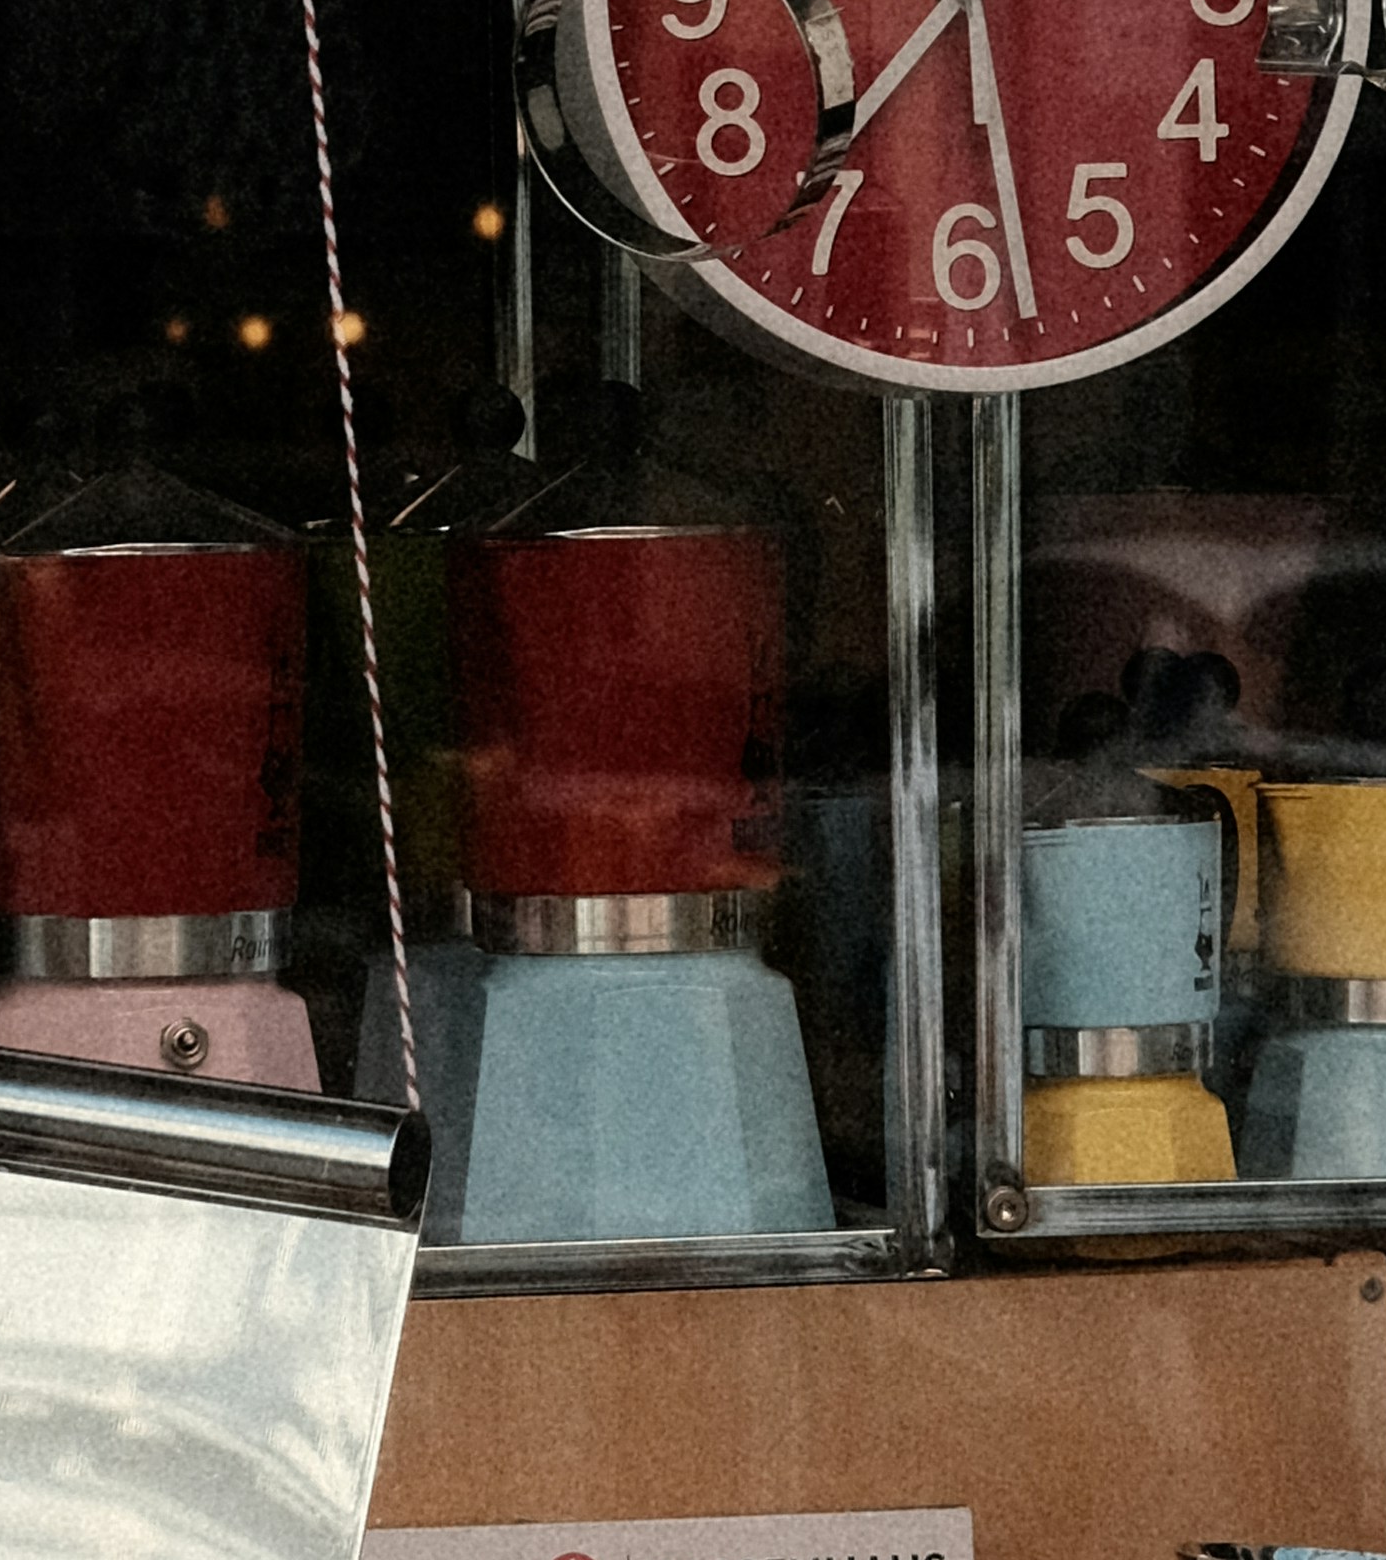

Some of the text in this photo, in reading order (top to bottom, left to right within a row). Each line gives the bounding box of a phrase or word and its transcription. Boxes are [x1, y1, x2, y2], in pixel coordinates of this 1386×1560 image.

[696, 69, 766, 175] 8
[1157, 59, 1229, 162] 4
[796, 170, 863, 276] 7
[932, 203, 1001, 311] 6
[1066, 163, 1134, 268] 5
